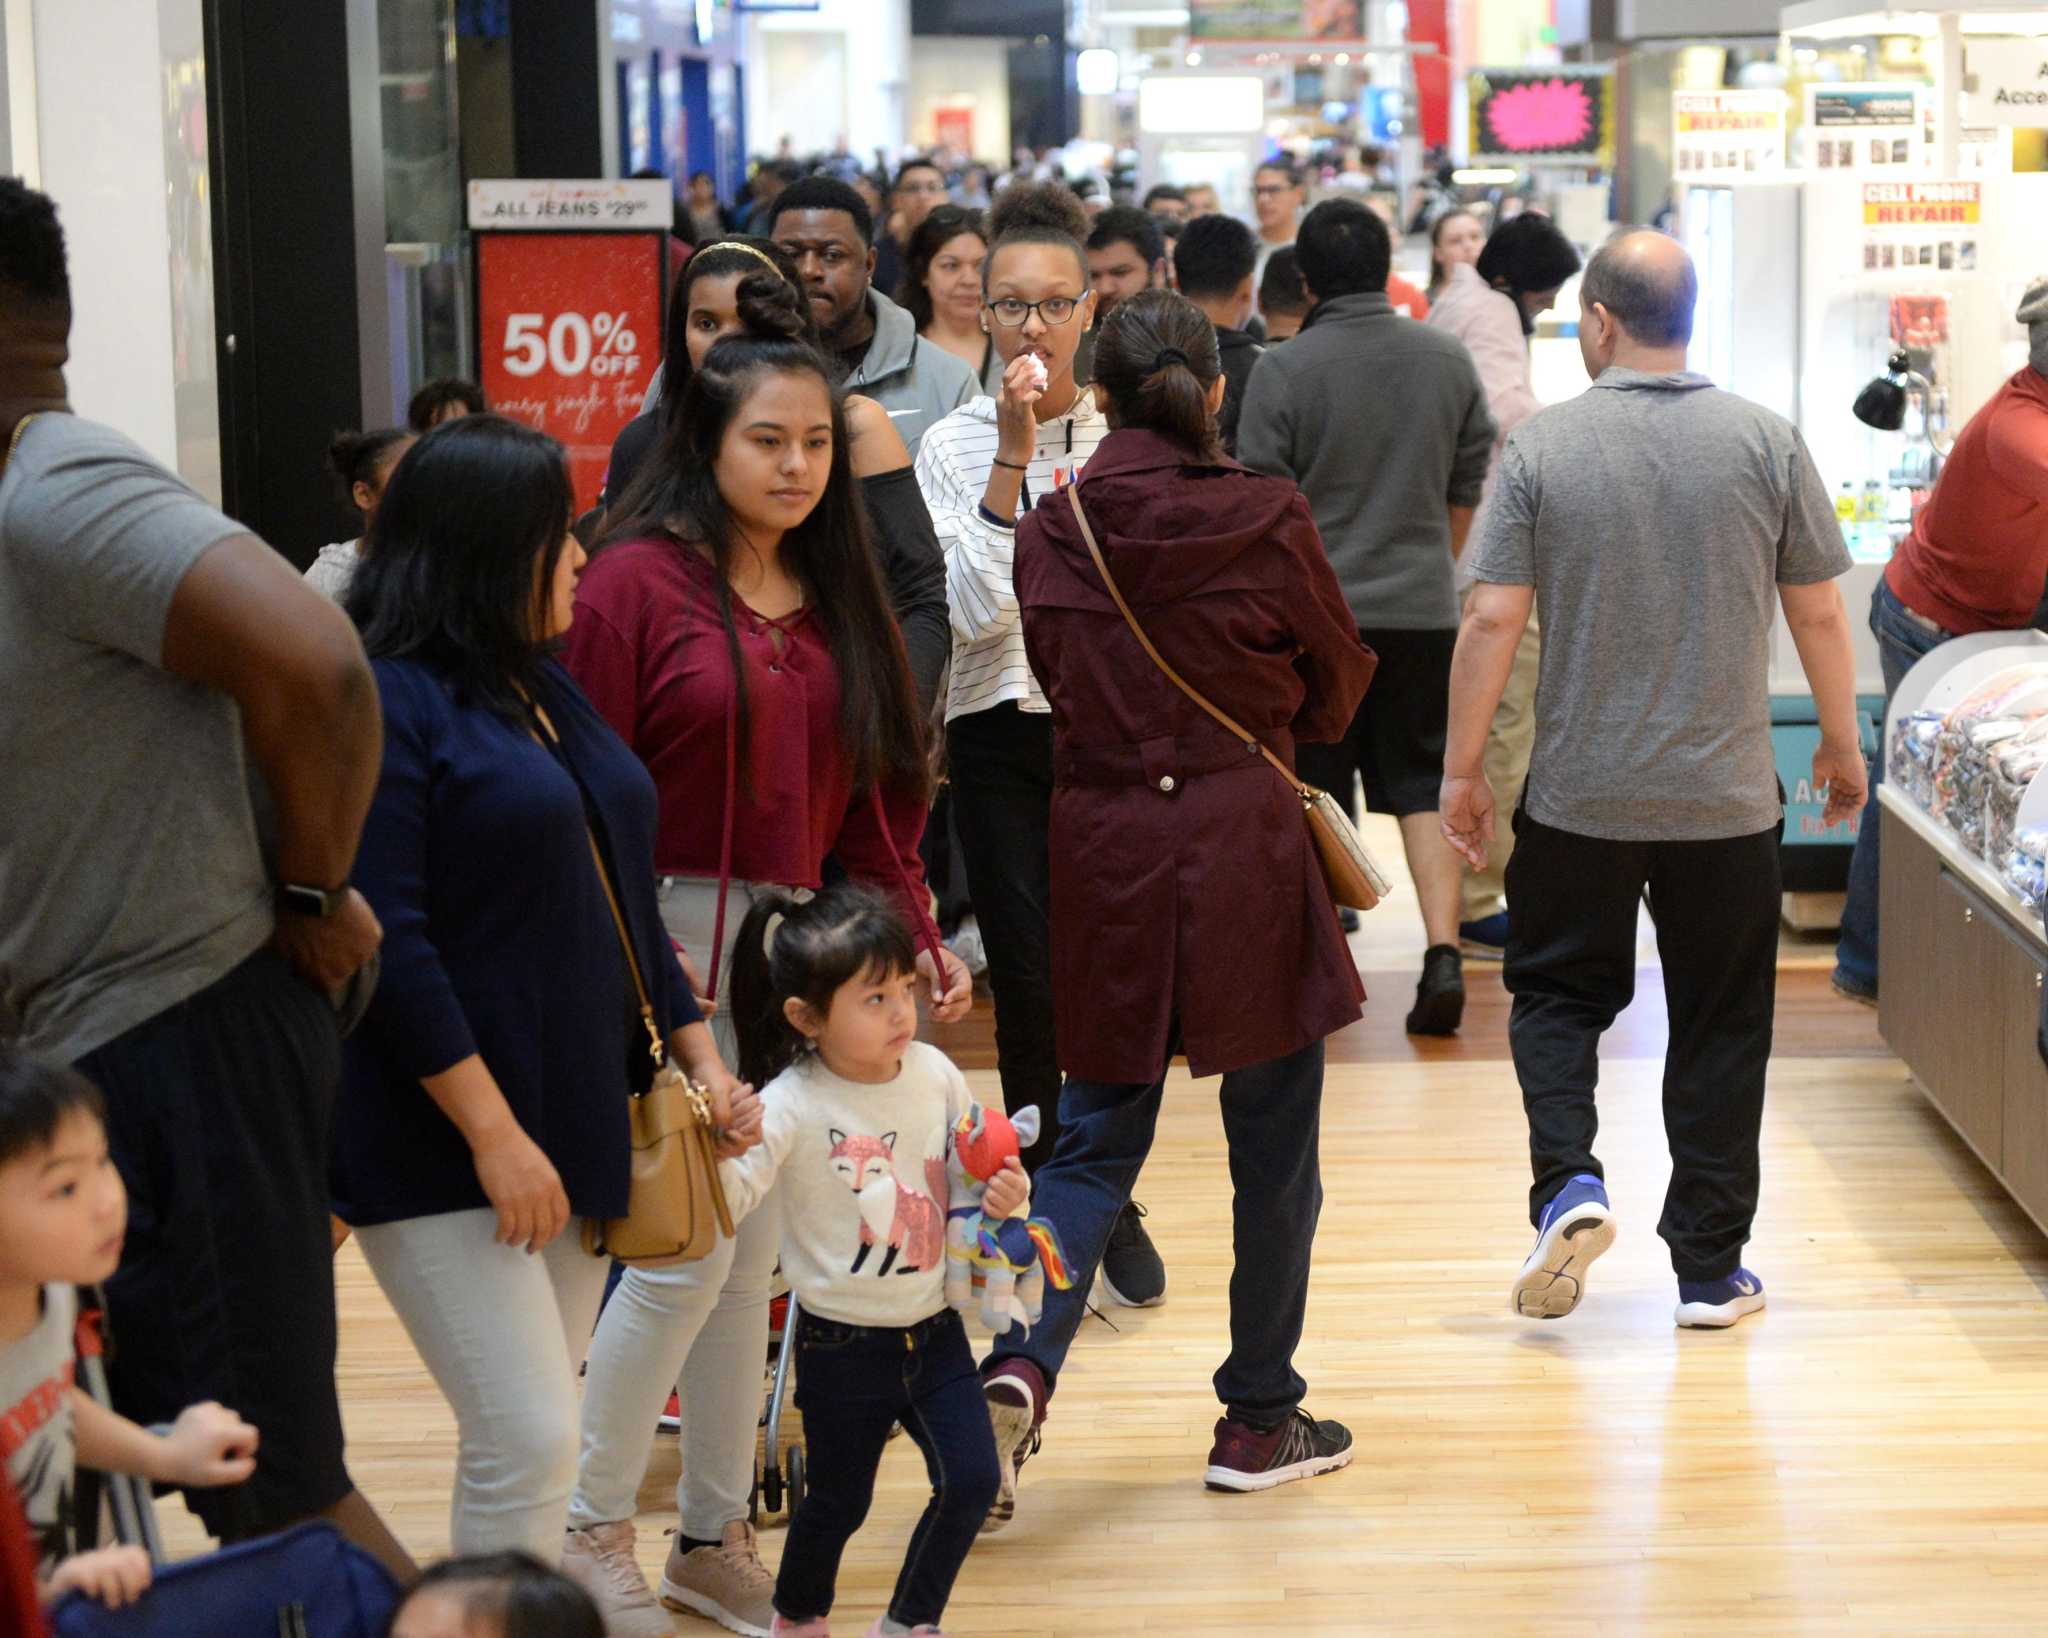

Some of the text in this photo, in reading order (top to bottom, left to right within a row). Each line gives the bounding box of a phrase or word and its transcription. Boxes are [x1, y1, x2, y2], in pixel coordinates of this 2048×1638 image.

[495, 201, 529, 217] ALL
[537, 201, 600, 217] JEANS
[1876, 206, 1966, 222] REPAIR
[503, 311, 637, 377] 50%
[591, 355, 640, 377] OFF
